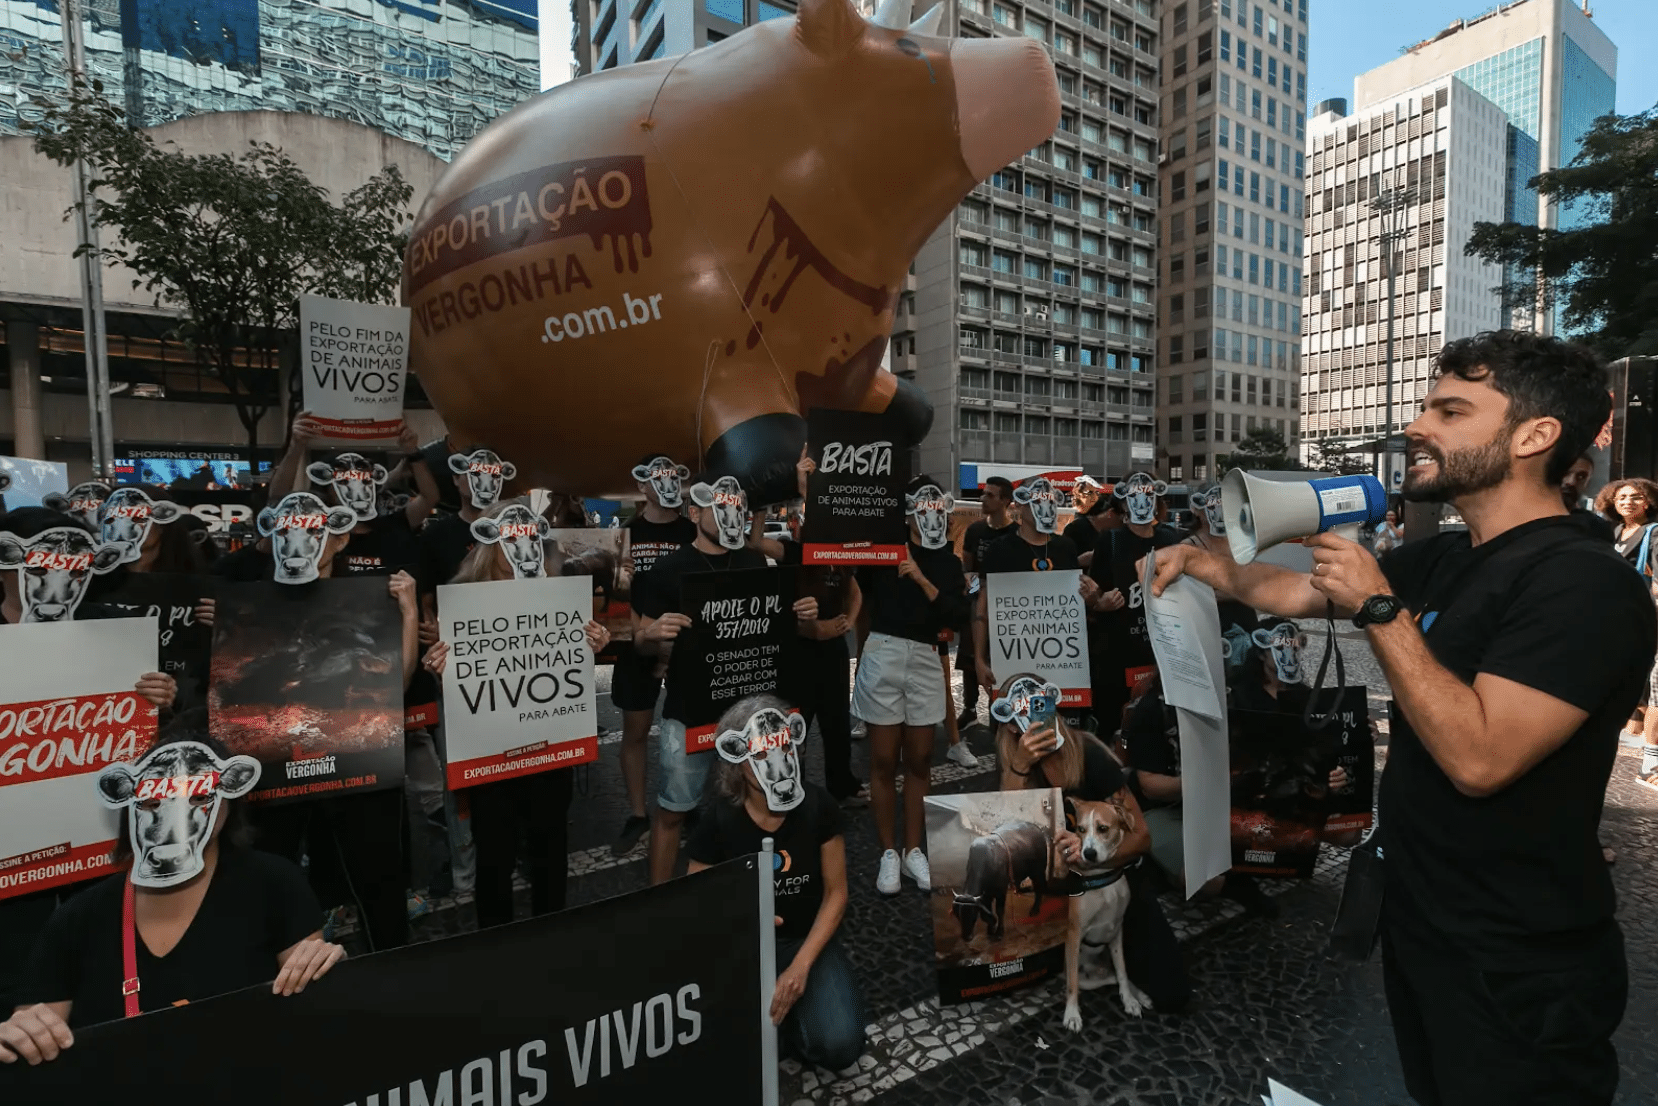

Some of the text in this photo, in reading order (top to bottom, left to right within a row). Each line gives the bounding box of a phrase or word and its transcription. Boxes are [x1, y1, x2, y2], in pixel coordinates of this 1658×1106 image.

[411, 167, 632, 276] EXPORTAÇÃO
[415, 253, 593, 338] VERGONHA
[541, 292, 663, 343] .com.br
[310, 321, 403, 342] PELO FIM DA
[310, 336, 403, 357] EXPORTAÇÃO
[311, 350, 402, 370] DE ANIMAIS
[312, 365, 399, 393] VIVOS
[128, 450, 186, 458] SHOPPING
[188, 451, 232, 459] CENTER
[819, 441, 893, 476] BASTA
[334, 469, 371, 480] BASTA
[828, 485, 887, 497] EXPORTAÇÃO
[818, 496, 898, 507] DE ANIMAIS VIVOS
[276, 514, 323, 529] BASTA
[832, 507, 885, 517] PARA ABATE
[27, 551, 91, 571] BASTA
[349, 555, 373, 565] NÃO
[701, 595, 783, 623] APOIE O PL
[995, 594, 1079, 608] PELO FIM DA
[169, 605, 195, 627] PL
[453, 610, 583, 637] PELO FIM DA
[996, 607, 1080, 621] EXPORTAÇÃO
[715, 617, 770, 639] 357/2018
[997, 622, 1080, 636] DE ANIMAIS
[453, 627, 584, 657] EXPORTAÇÃO
[998, 636, 1080, 660] VIVOS
[456, 648, 585, 680] DE ANIMAIS
[706, 645, 780, 663] O SENADO TEM
[713, 657, 774, 675] O PODER DE
[1036, 661, 1083, 670] PARA ABATE
[710, 669, 777, 688] ACABAR COM
[458, 668, 585, 715] VIVOS
[711, 681, 776, 700] ESSE TERROR
[519, 703, 587, 722] PARA ABATE
[0, 730, 137, 777] GONHA
[464, 747, 585, 780] EXPORTACAOVERGONHA.COM.BR
[286, 761, 336, 779] VERGONHA
[138, 774, 214, 799] BASTA
[24, 854, 31, 863] A
[785, 874, 810, 887] FOR
[343, 983, 702, 1106] MAIS VIVOS
